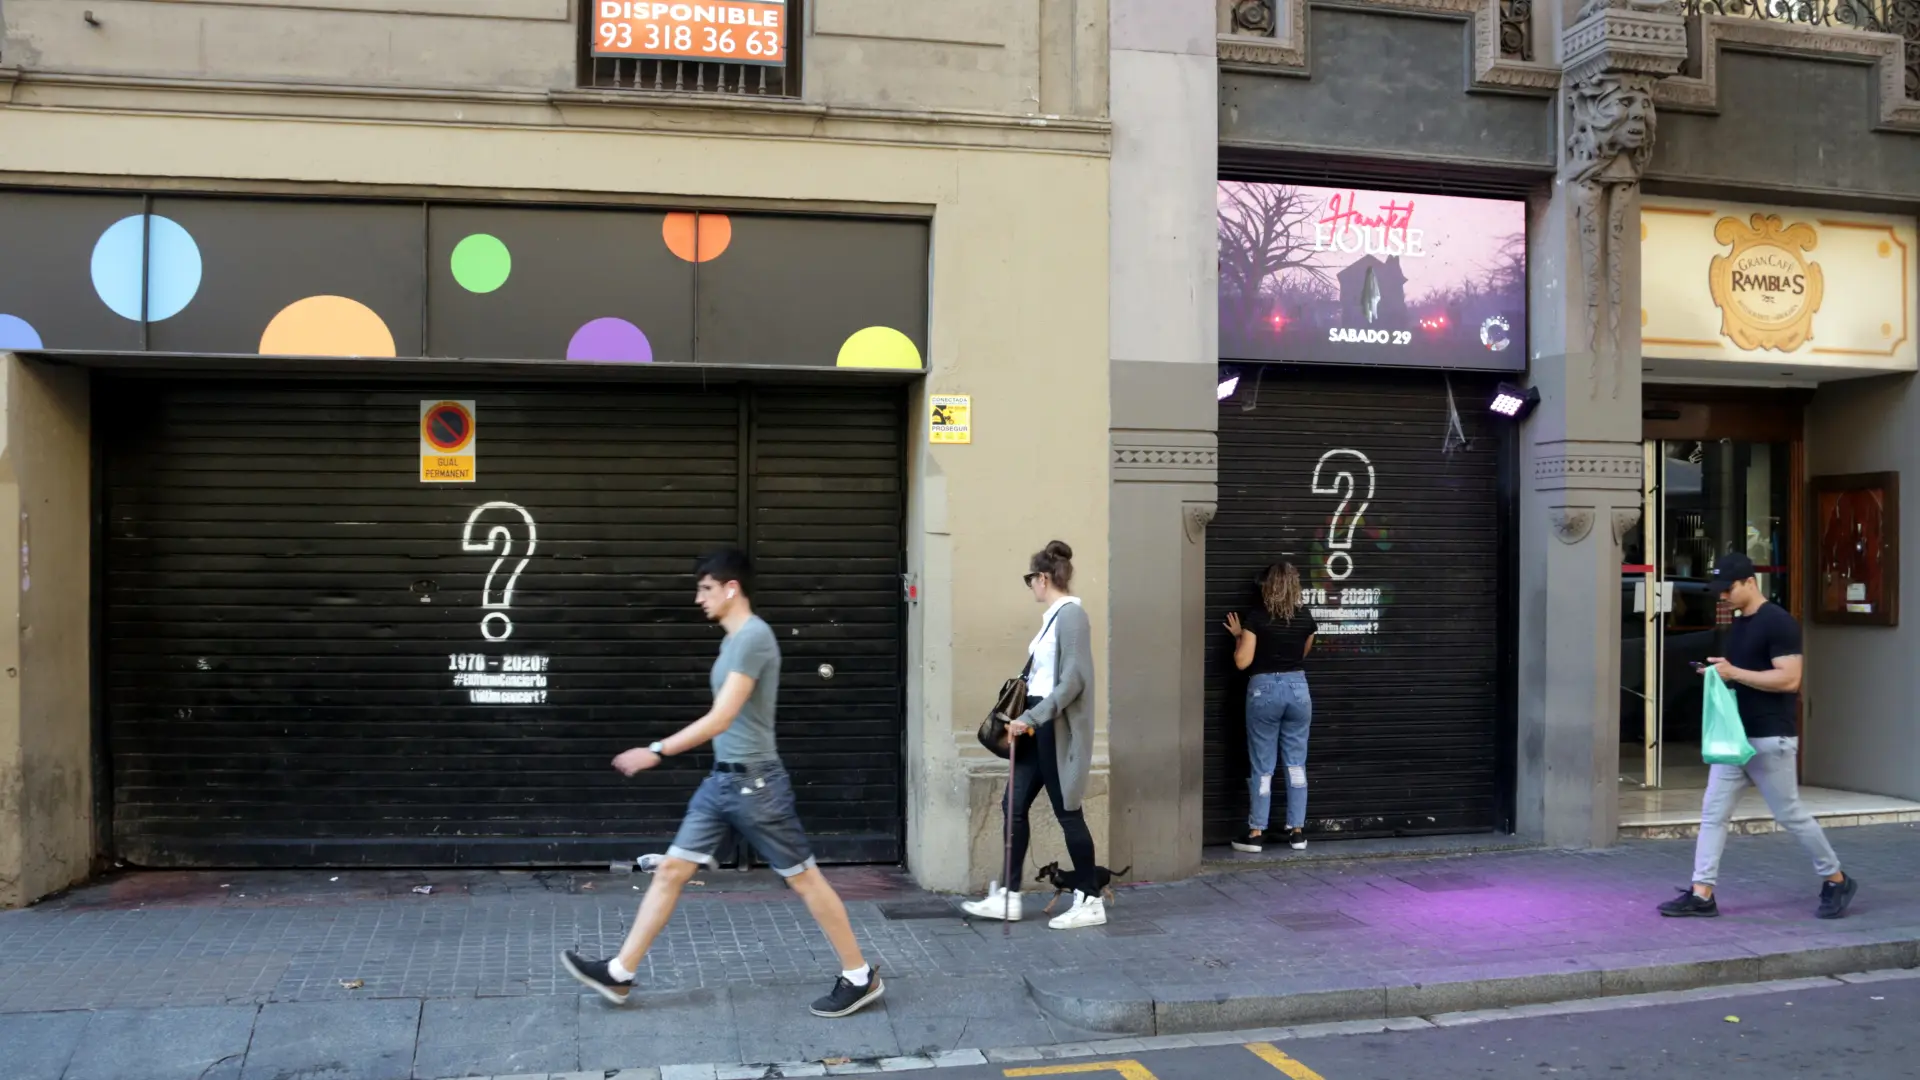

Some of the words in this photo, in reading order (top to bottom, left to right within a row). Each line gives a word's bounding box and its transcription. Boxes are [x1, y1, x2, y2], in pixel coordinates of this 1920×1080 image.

[601, 1, 778, 26] DISPONIBLE
[600, 22, 632, 47] 93
[644, 24, 692, 51] 318
[702, 27, 736, 53] 36
[746, 30, 778, 56] 63
[1319, 191, 1415, 247] Haunted
[1313, 222, 1426, 257] HOUSE
[1738, 256, 1767, 271] GRAN
[1731, 270, 1805, 295] RAMBLAS
[1329, 328, 1389, 344] SABADO
[1392, 331, 1411, 344] 29
[425, 469, 469, 478] PERMANENT
[1301, 588, 1326, 604] 970
[448, 653, 486, 671] 1970
